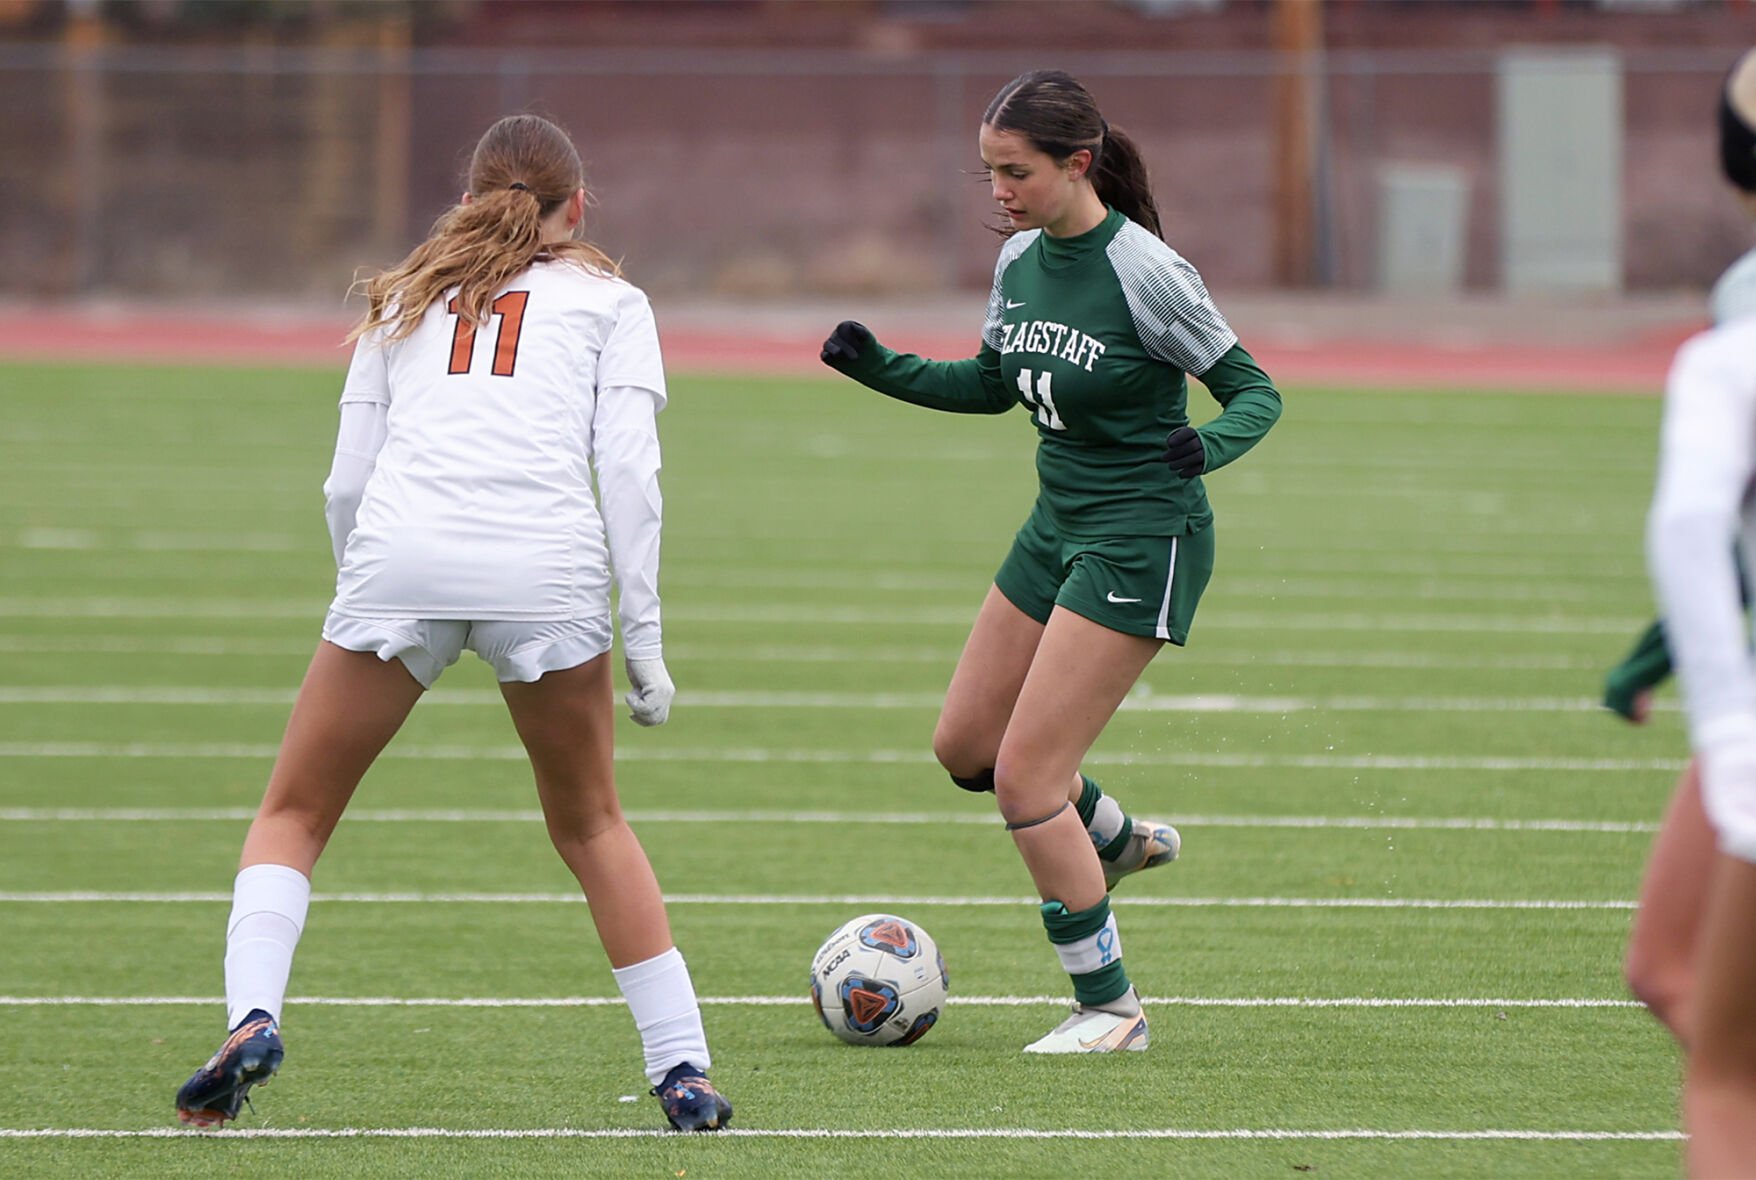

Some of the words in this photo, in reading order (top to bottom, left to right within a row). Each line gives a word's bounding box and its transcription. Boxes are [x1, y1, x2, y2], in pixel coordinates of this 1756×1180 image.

[447, 290, 530, 377] 11
[1016, 368, 1067, 431] 11
[822, 949, 850, 980] NCAA
